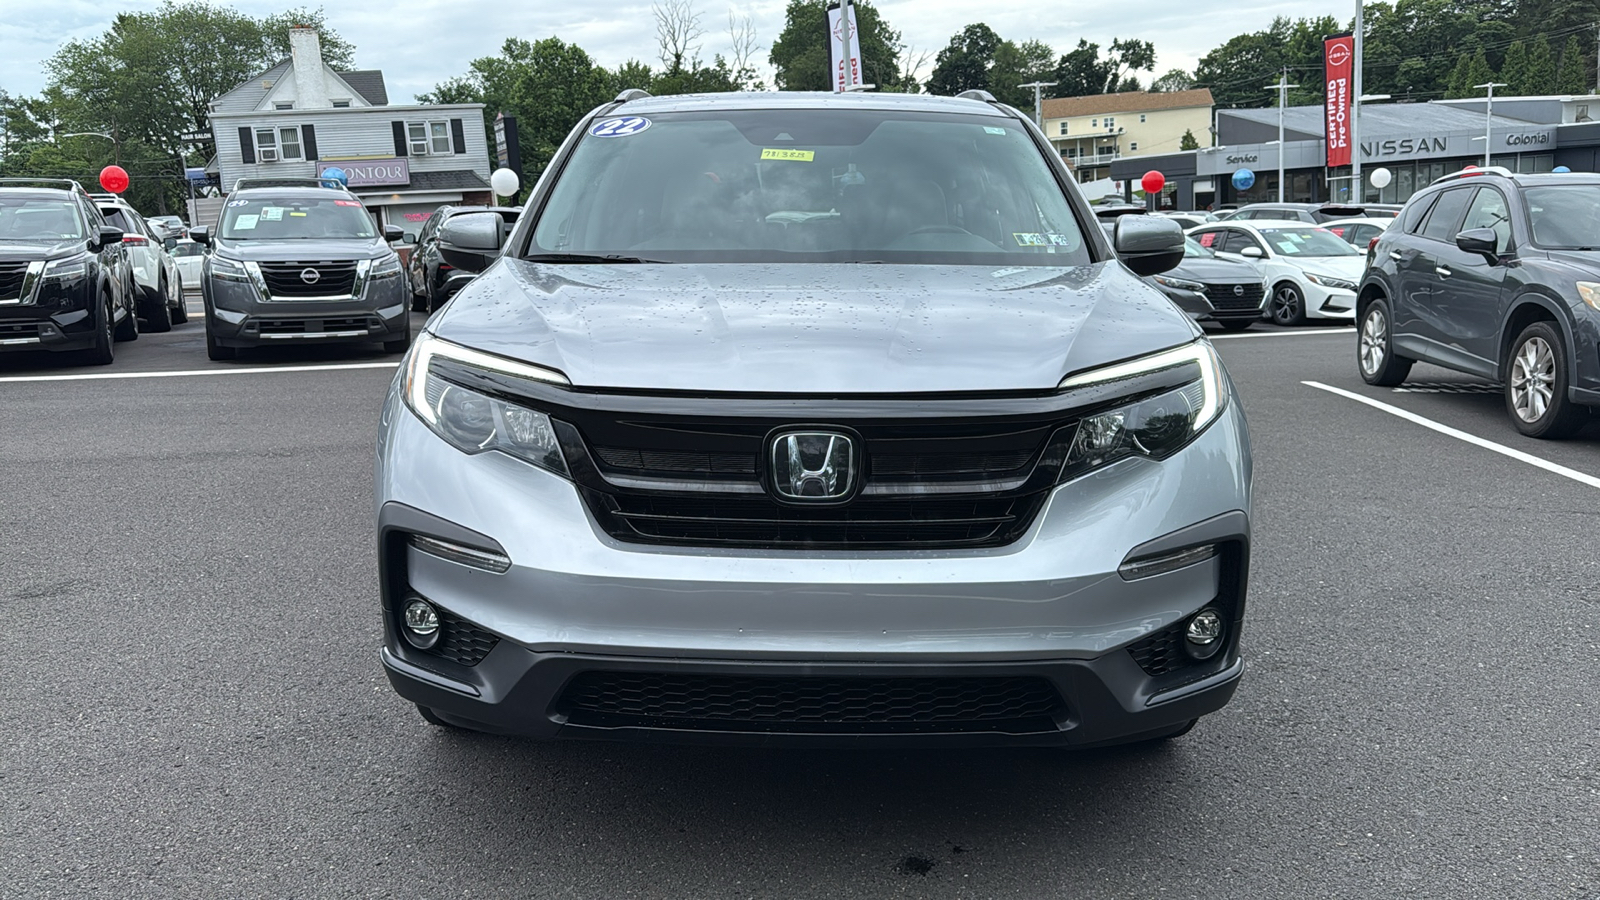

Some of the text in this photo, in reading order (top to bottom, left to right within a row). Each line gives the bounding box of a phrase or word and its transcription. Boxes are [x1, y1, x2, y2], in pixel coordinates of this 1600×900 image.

[1328, 80, 1336, 149] CERTIFIED
[1336, 78, 1346, 148] Pre-Owned
[595, 118, 644, 135] 22
[1360, 137, 1447, 157] NISSAN
[1506, 132, 1550, 146] Colonial
[1226, 154, 1258, 164] Service
